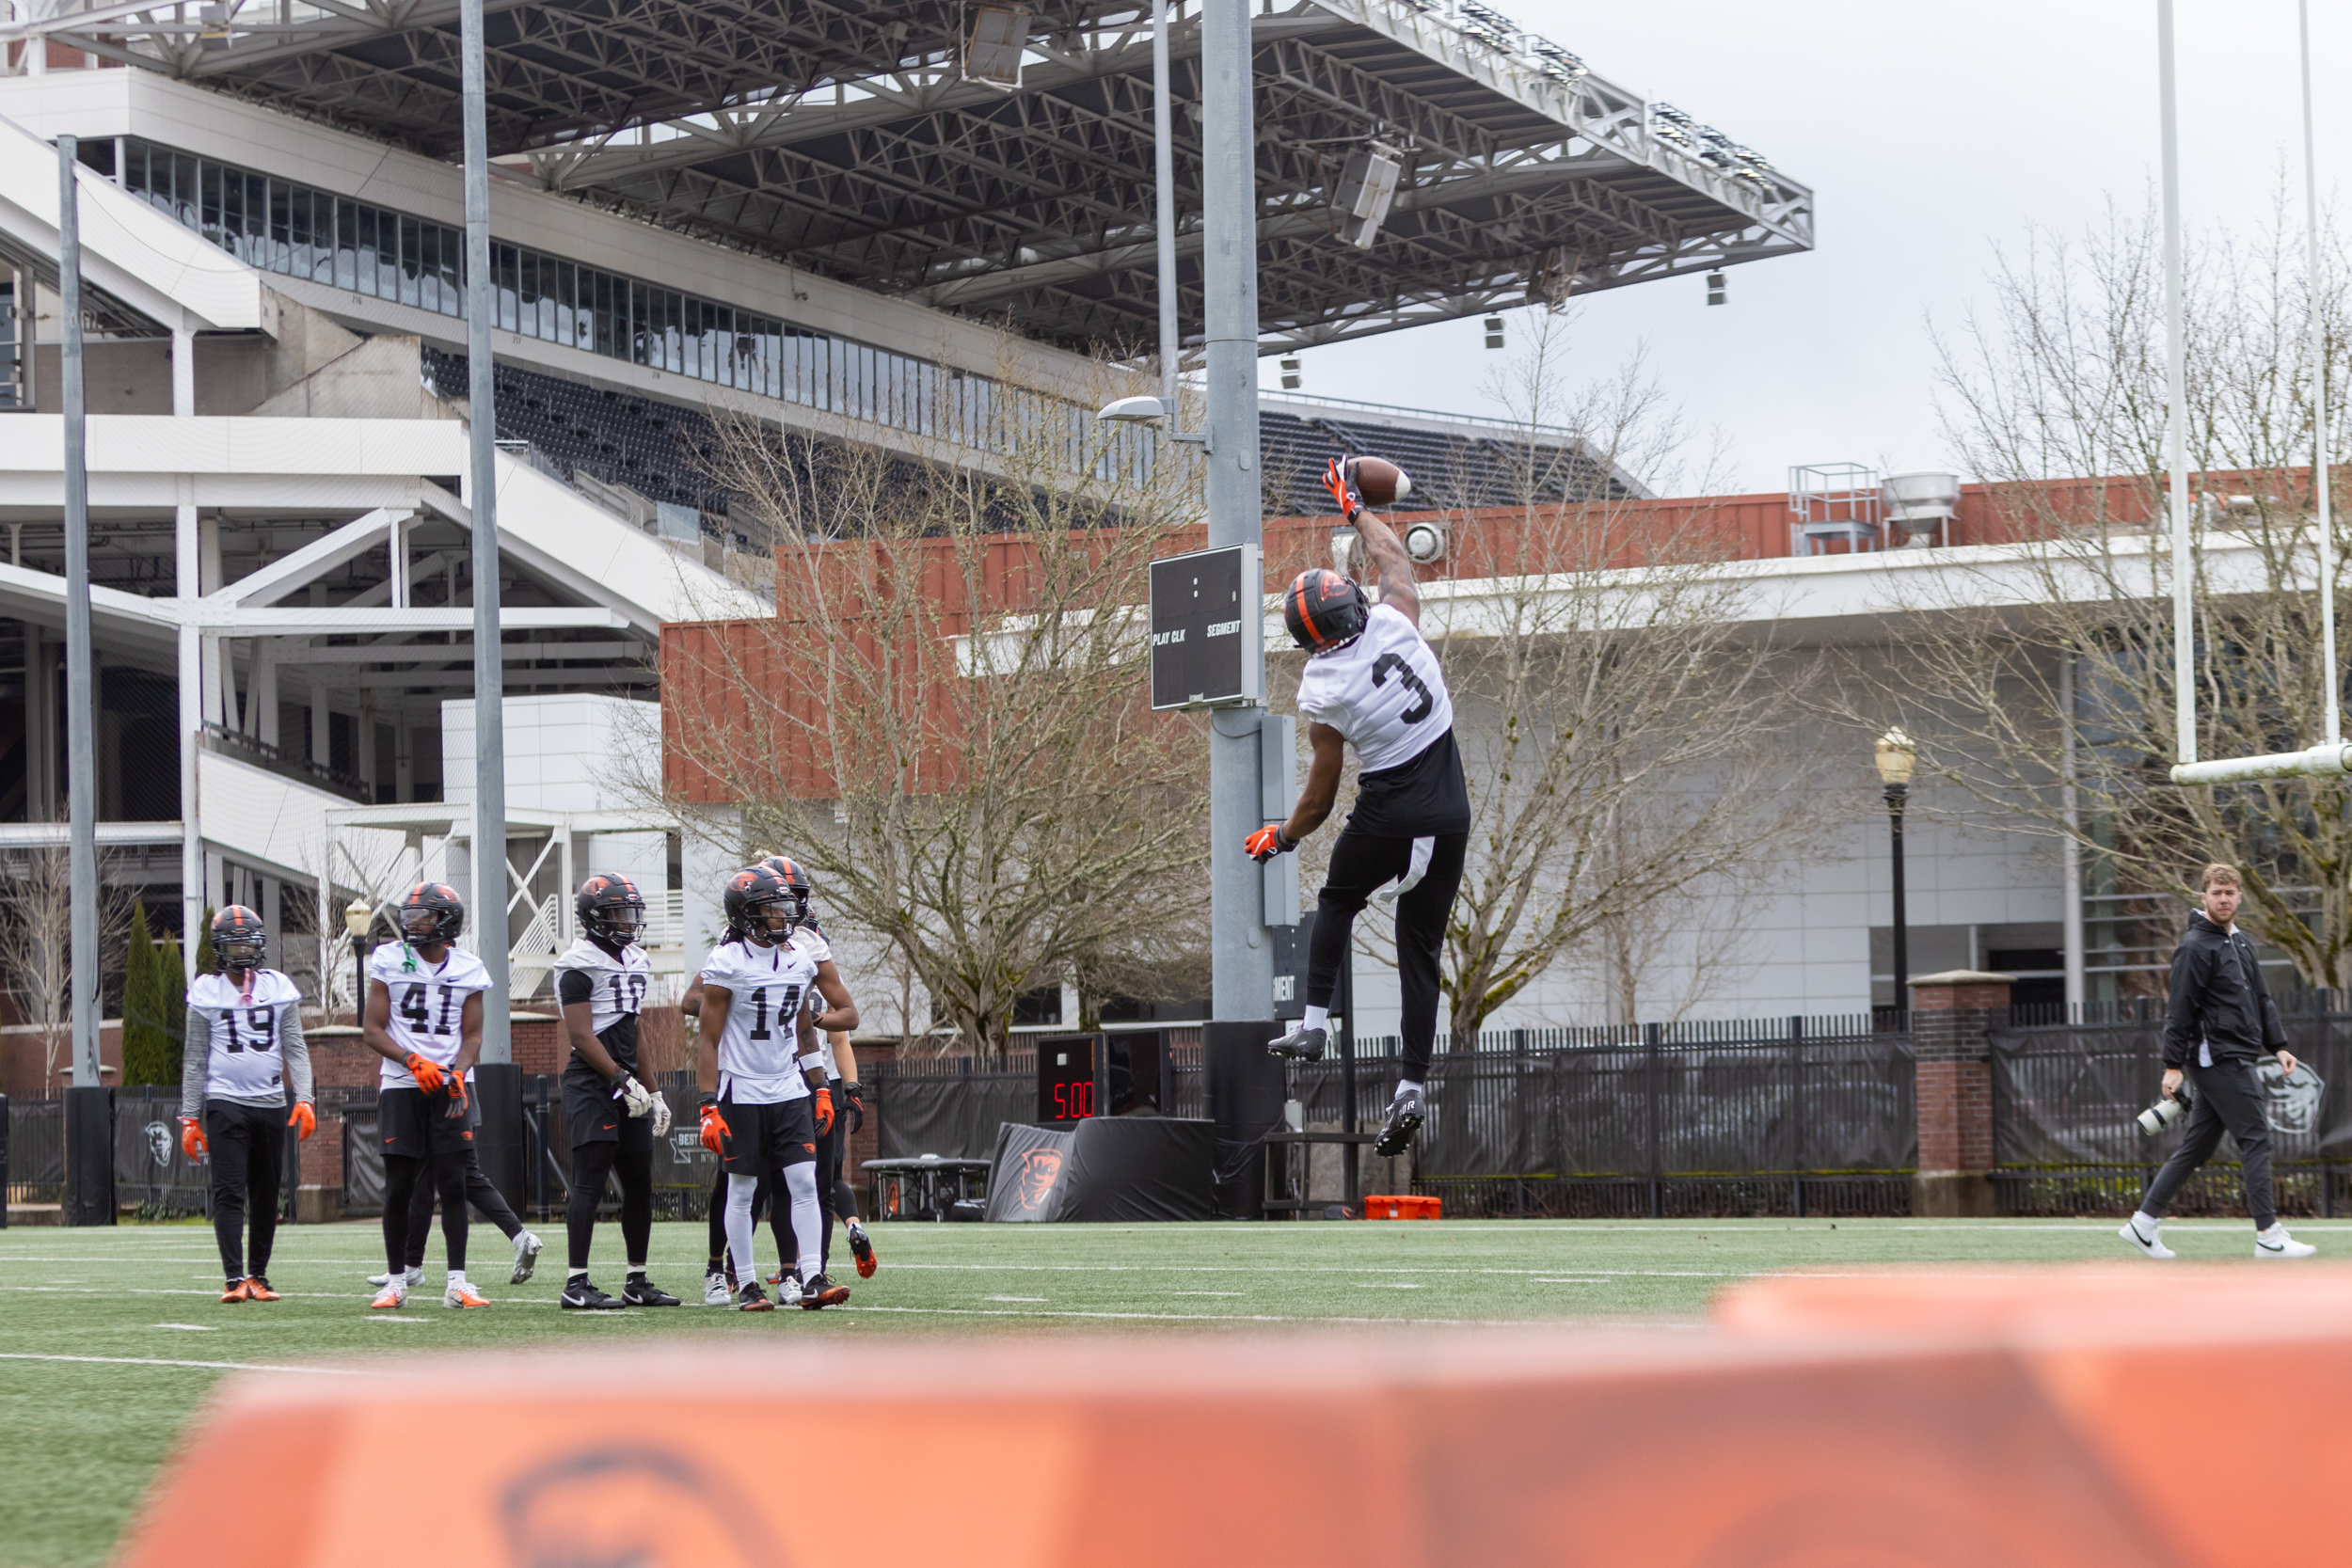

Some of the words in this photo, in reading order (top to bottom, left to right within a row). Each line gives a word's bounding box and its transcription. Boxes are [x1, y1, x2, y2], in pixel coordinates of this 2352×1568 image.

[1152, 631, 1170, 647] PLAY
[1170, 628, 1186, 643] CLK
[1206, 620, 1242, 638] SEGMENT
[1372, 653, 1434, 724] 3
[1273, 974, 1295, 1002] MENT
[400, 982, 452, 1036] 41
[750, 985, 800, 1040] 14
[220, 1005, 275, 1053] 19
[678, 1132, 699, 1147] BEST
